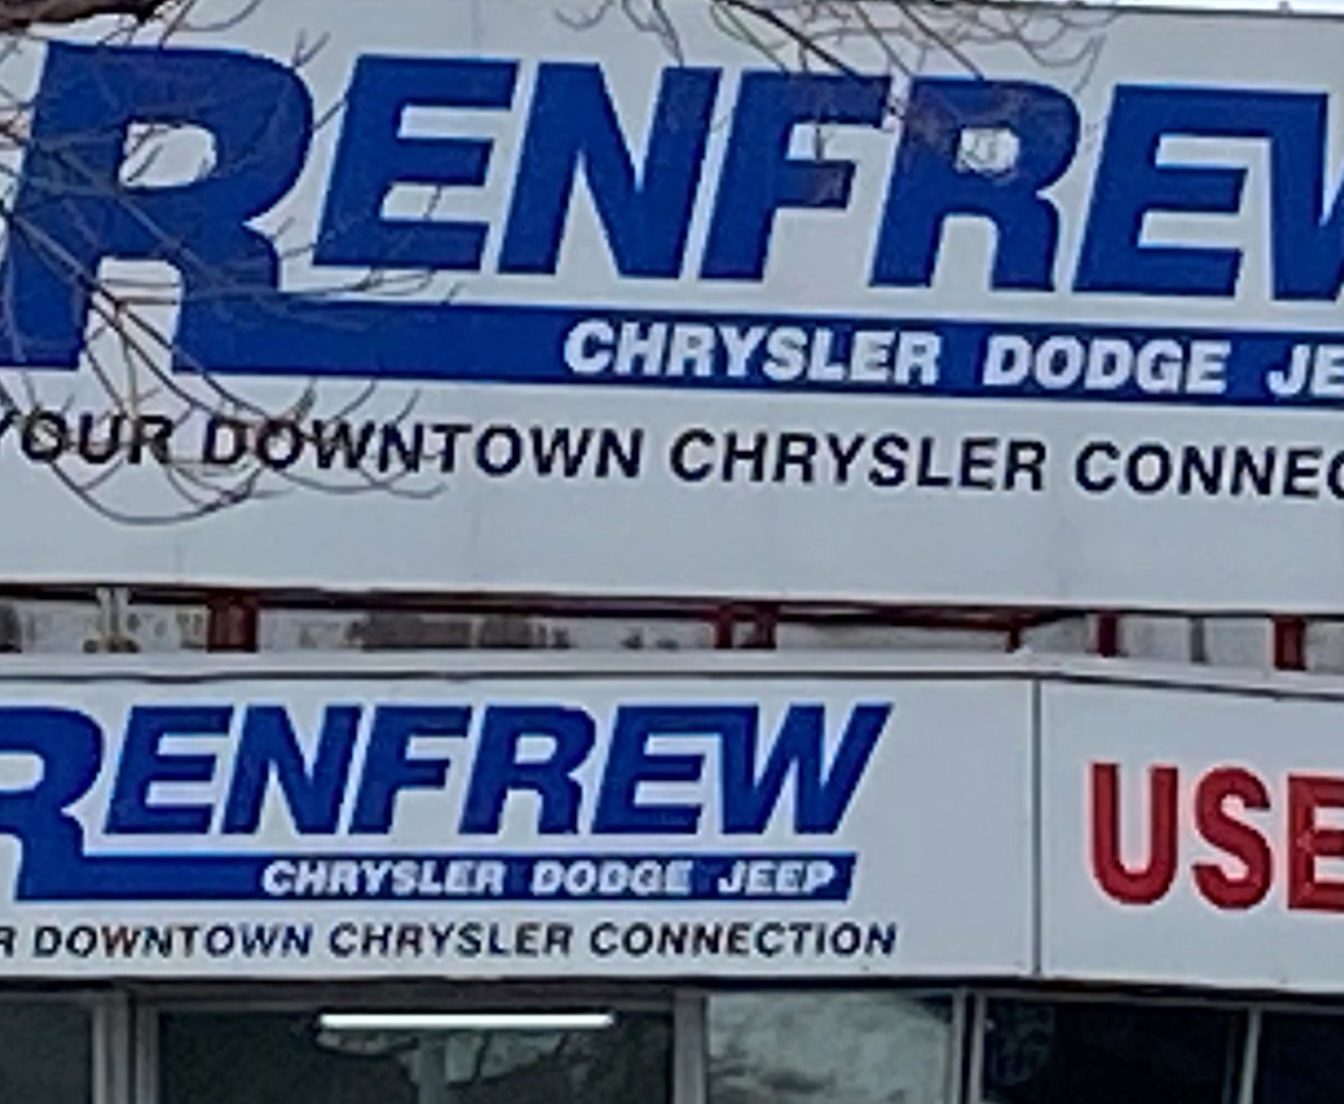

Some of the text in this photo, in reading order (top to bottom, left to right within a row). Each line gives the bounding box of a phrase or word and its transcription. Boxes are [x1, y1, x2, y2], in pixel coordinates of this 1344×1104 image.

[564, 320, 940, 385] CHRYSLER
[984, 333, 1231, 395] DODGE
[202, 417, 644, 479] DOWNTOWN
[670, 429, 1046, 492] CHRYSLER
[263, 860, 836, 896] CHRYSLER DODGE JEEP
[33, 924, 313, 959] DOWNTOWN
[328, 922, 574, 958] CHRYSLER
[589, 921, 898, 958] CONNECTION
